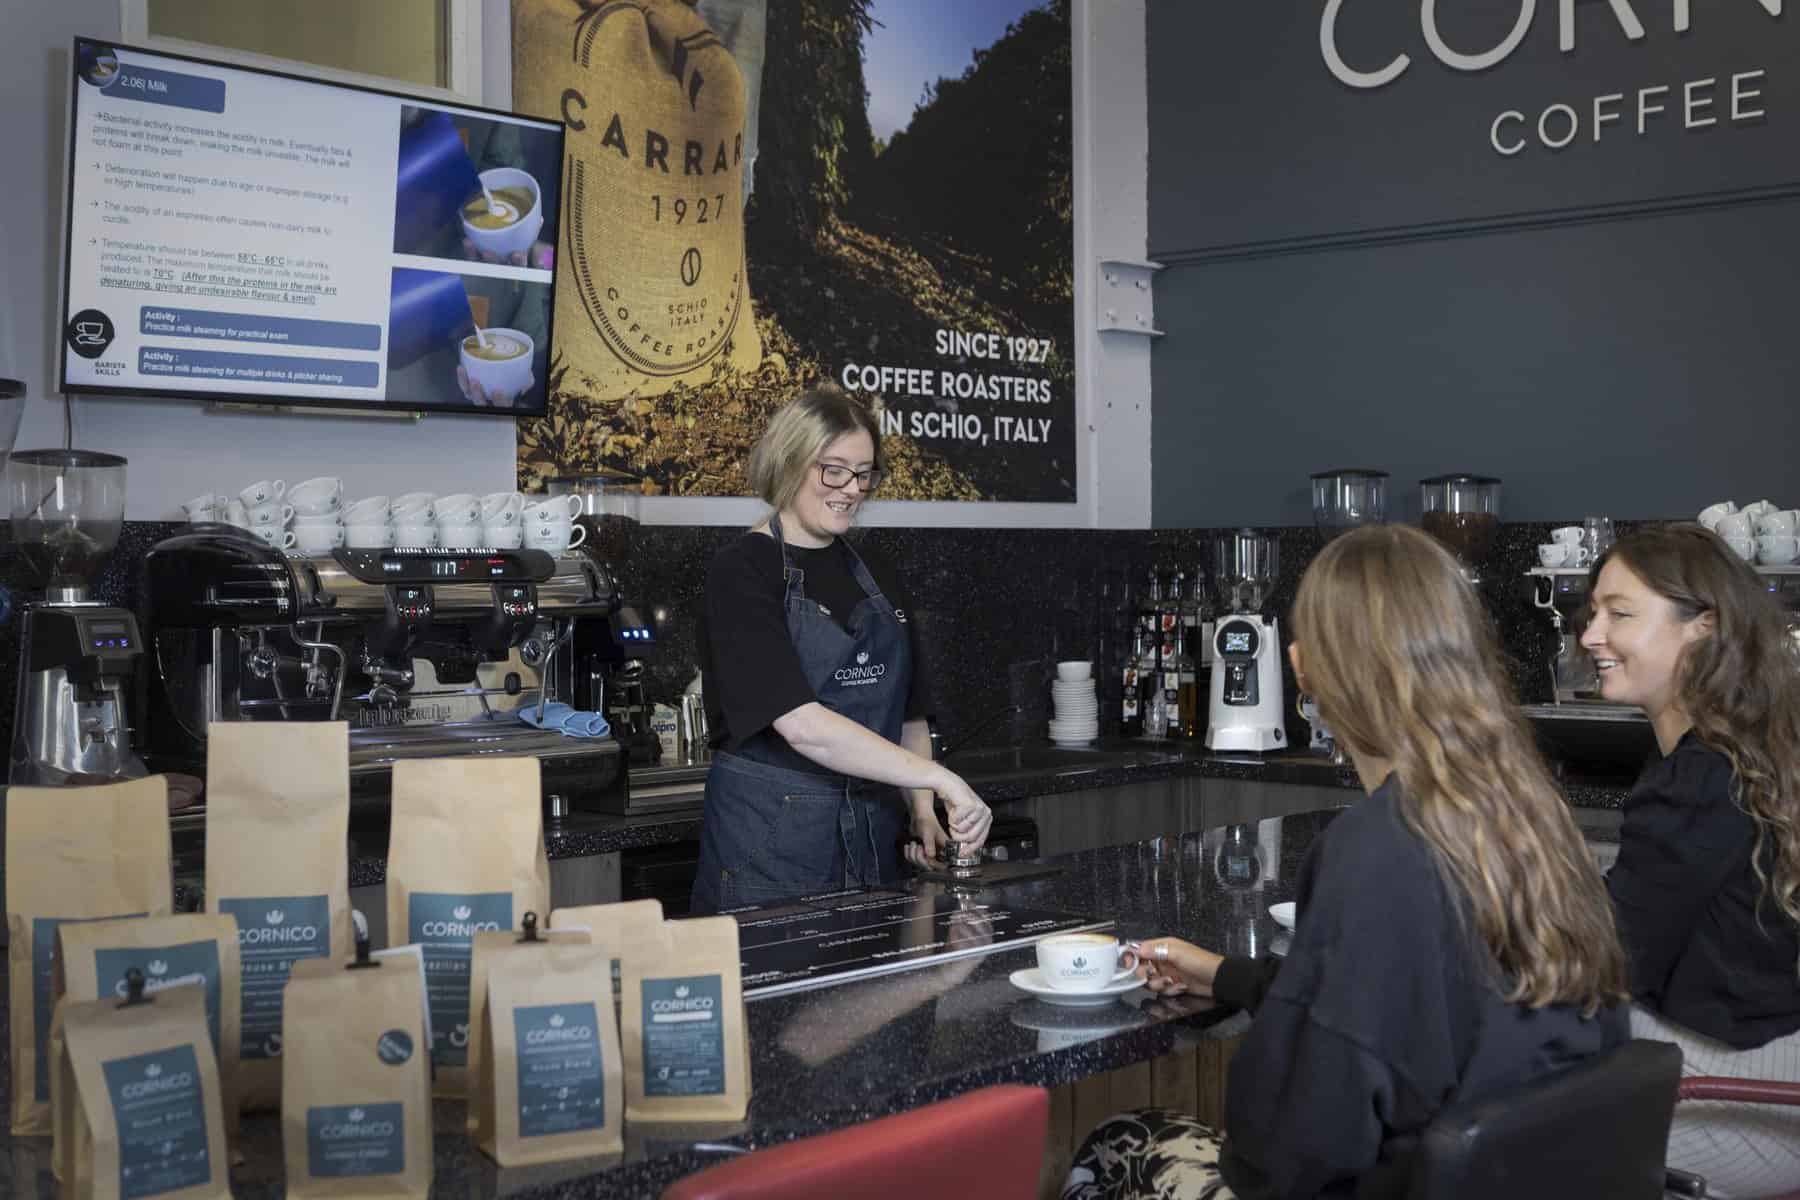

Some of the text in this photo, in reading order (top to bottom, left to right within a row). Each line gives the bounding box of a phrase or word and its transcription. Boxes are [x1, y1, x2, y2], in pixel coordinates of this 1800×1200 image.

[147, 79, 168, 93] Milk
[1490, 69, 1765, 155] COFFEE
[144, 118, 172, 133] activity
[217, 129, 230, 139] the
[651, 193, 726, 225] 1927
[145, 310, 176, 322] Activity
[668, 298, 707, 315] SCHIO
[607, 286, 673, 356] COFFEE
[143, 350, 174, 362] Activity
[935, 329, 1051, 364] SINCE 1927
[841, 363, 1051, 404] COFFEE ROASTERS
[910, 411, 988, 447] SCHIO,
[994, 415, 1051, 443] ITALY
[834, 663, 885, 681] CORNICO
[236, 926, 317, 944] CORNICO
[422, 920, 499, 937] CORNICO
[651, 997, 713, 1012] CORNICO
[526, 1025, 592, 1044] CORNICO
[121, 1071, 192, 1099] CORNICO
[320, 1120, 394, 1140] CORNICO
